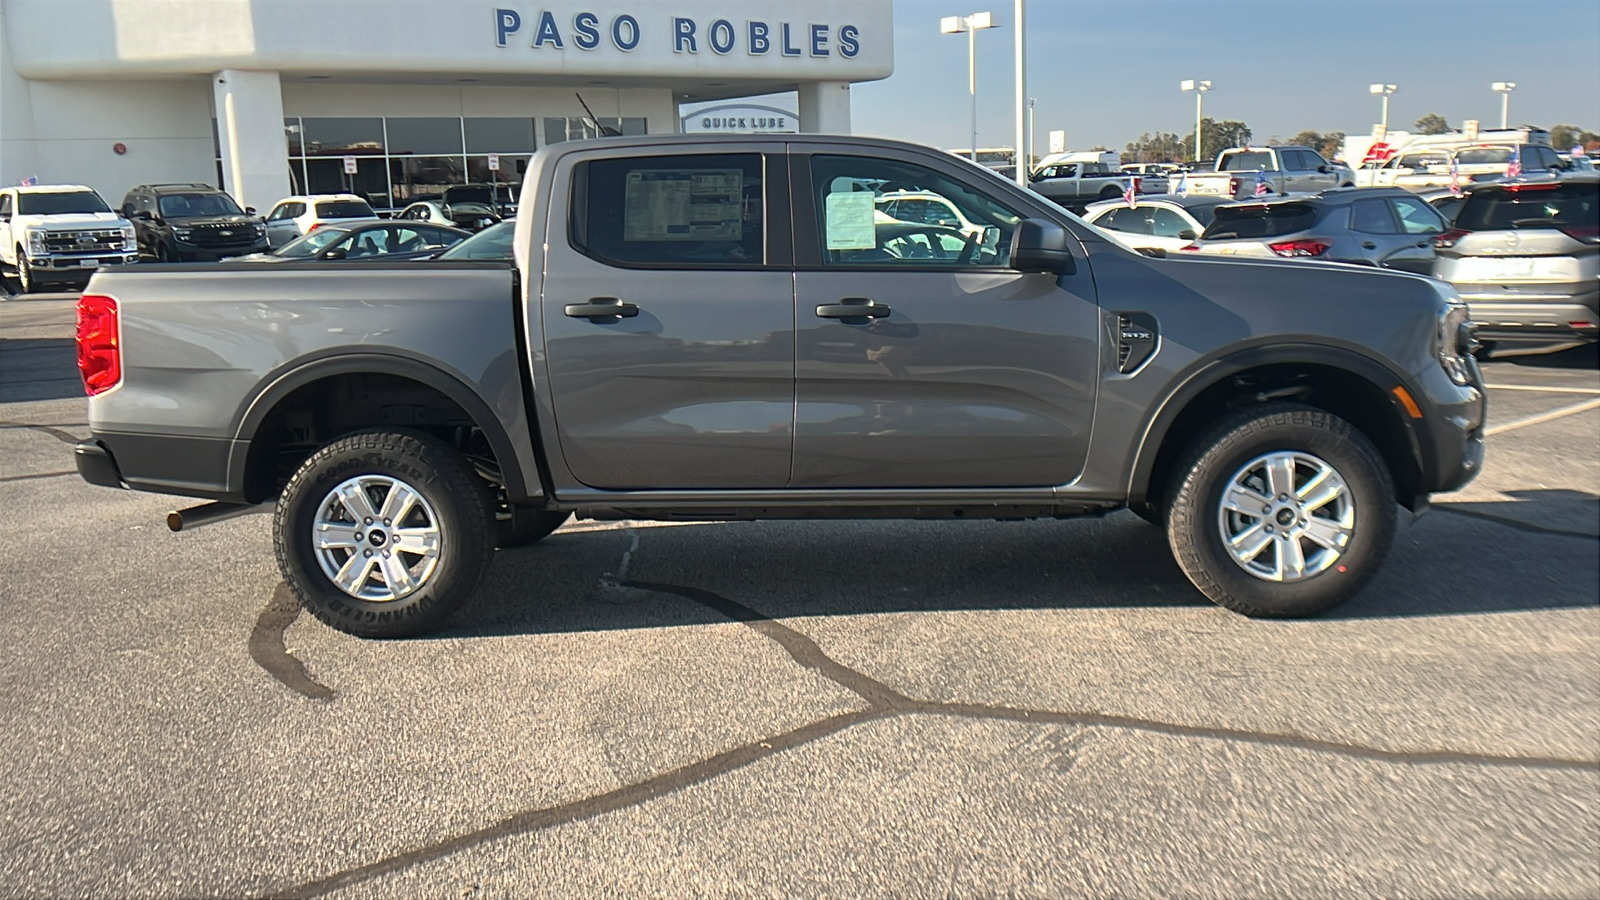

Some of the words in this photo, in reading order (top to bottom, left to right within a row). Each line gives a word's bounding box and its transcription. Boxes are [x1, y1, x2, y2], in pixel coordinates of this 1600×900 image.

[495, 8, 641, 51] PASO
[672, 16, 860, 59] ROBLES
[702, 117, 746, 129] QUICK
[751, 117, 785, 129] LUBE
[316, 456, 423, 484] GOODYEAR
[327, 594, 436, 623] WRANGLER
